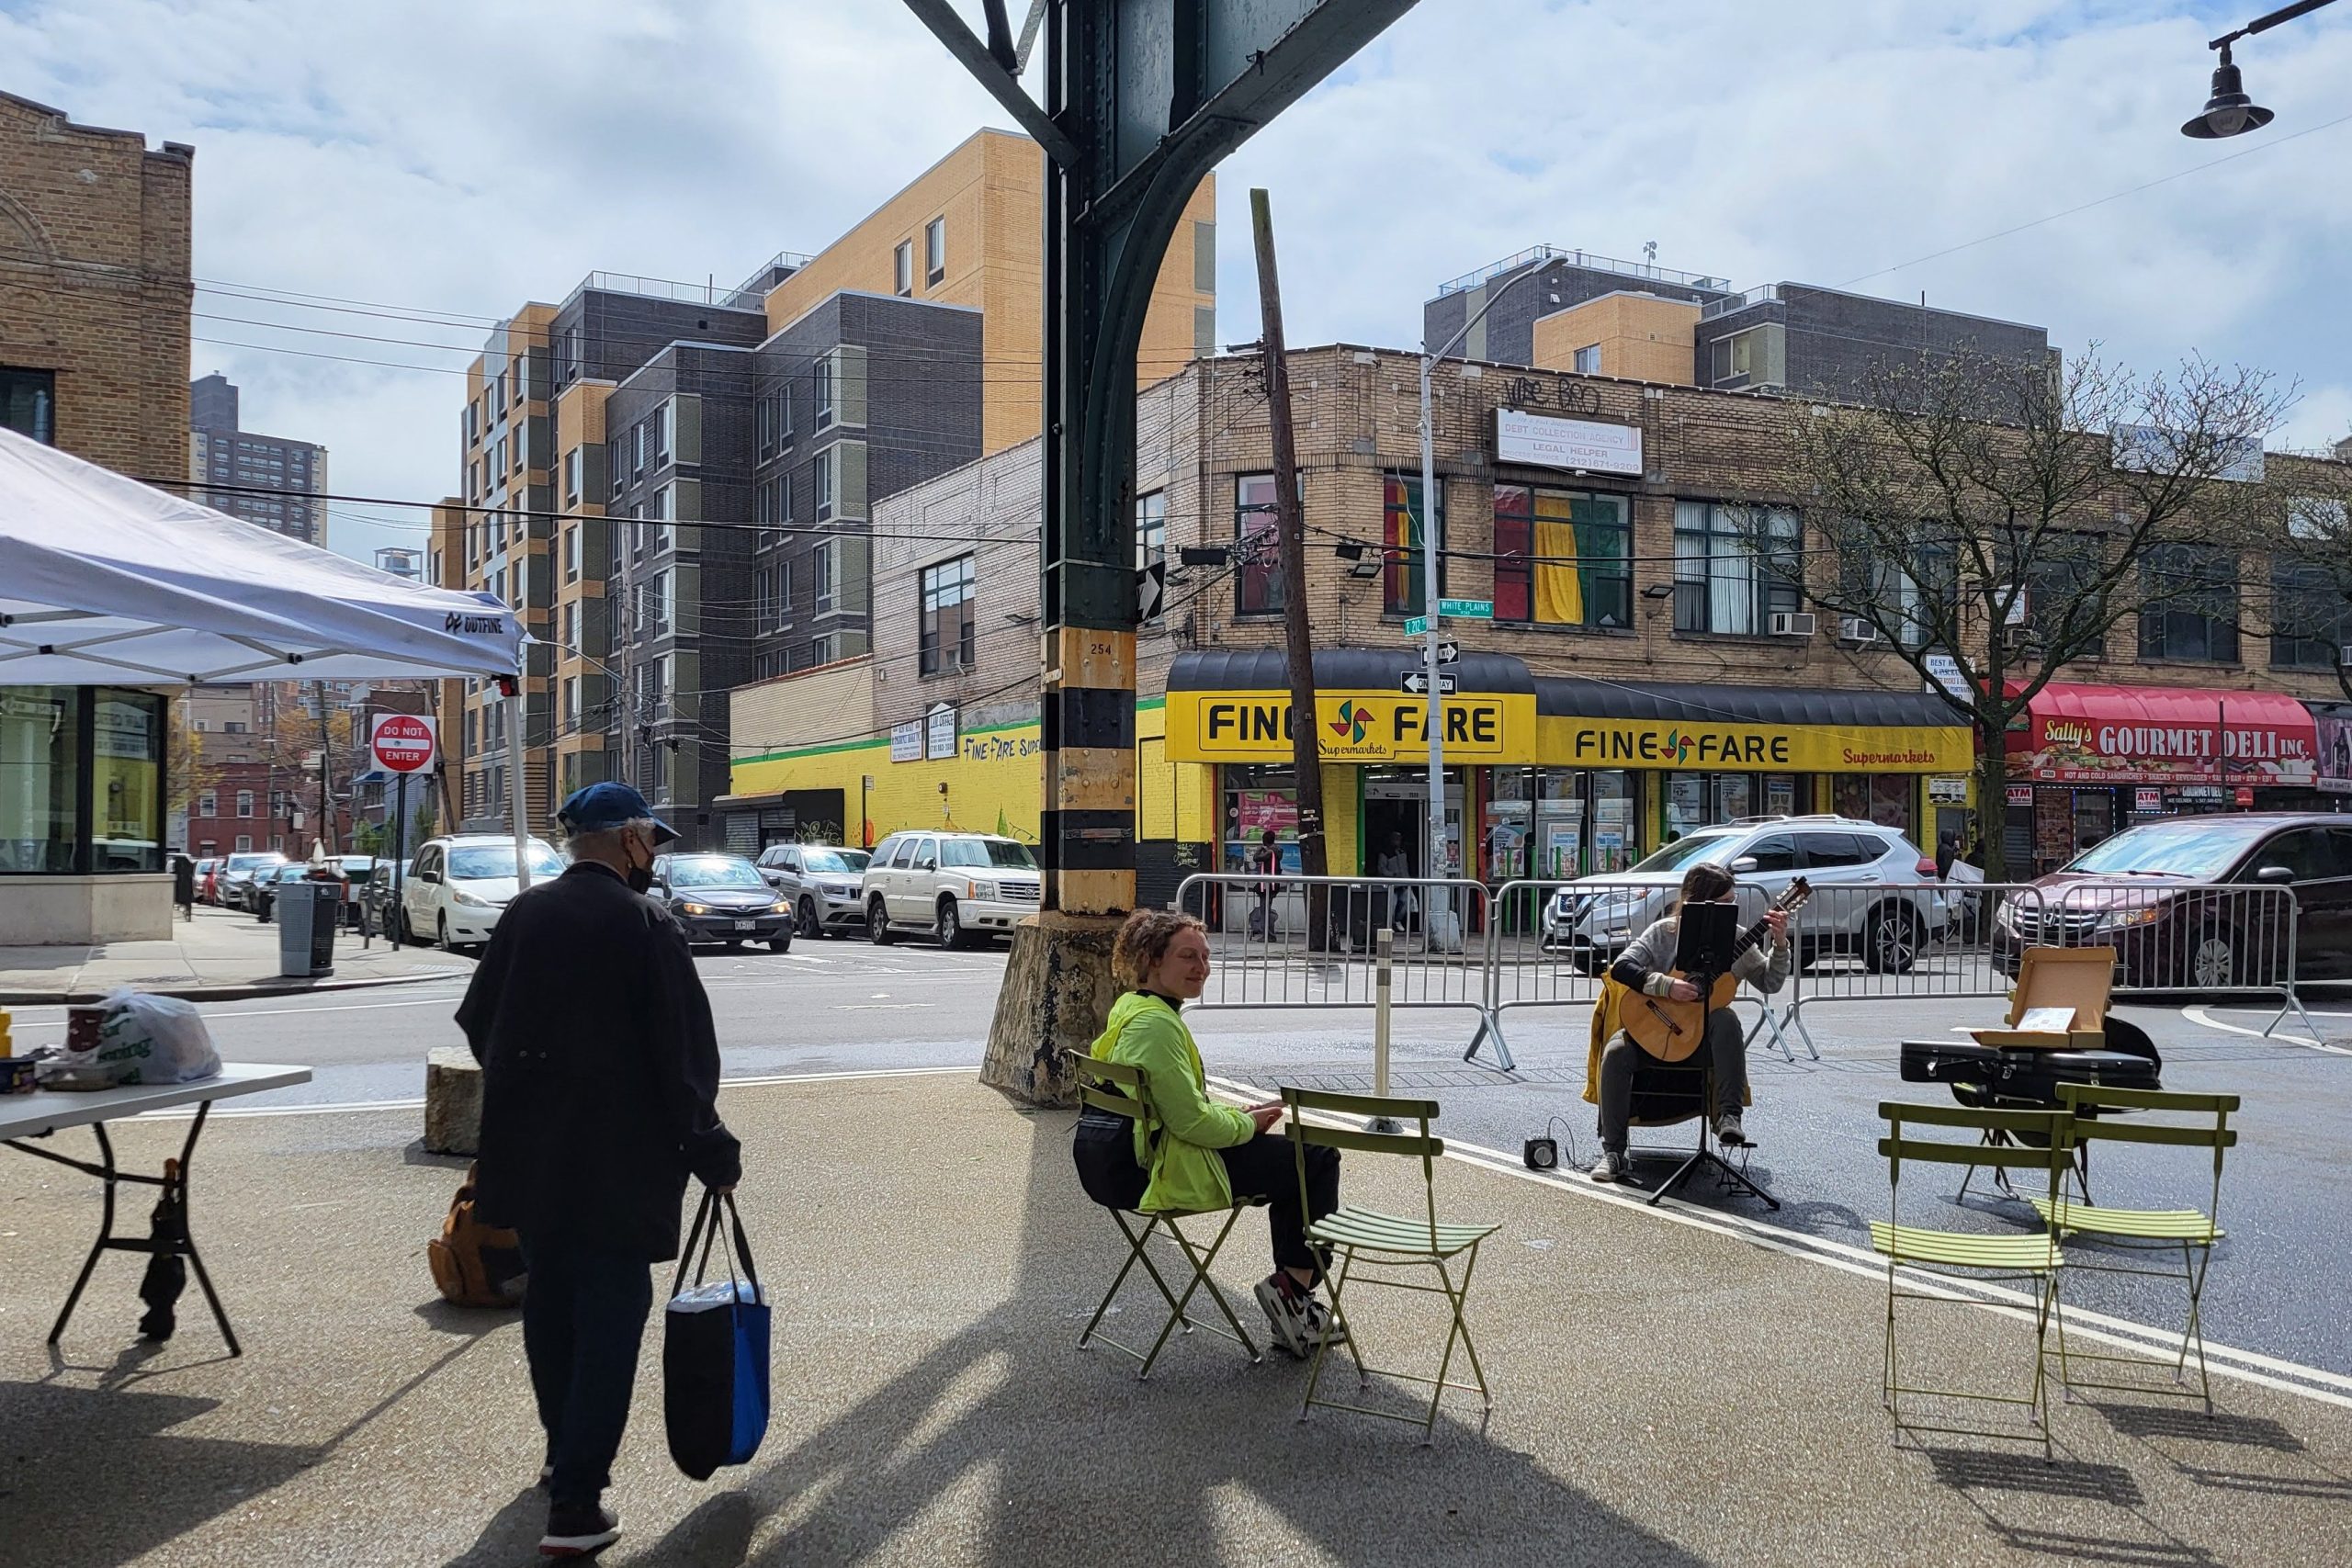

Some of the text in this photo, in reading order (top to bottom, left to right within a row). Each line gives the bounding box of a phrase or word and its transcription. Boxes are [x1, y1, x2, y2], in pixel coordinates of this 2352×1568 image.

[1505, 423, 1529, 434] DEBT
[1532, 426, 1587, 441] COLLECTION
[1589, 432, 1624, 446] AGENCY
[1532, 442, 1608, 458] LEGAL HELPER
[1442, 601, 1489, 612] WHITE PLAINS
[465, 616, 503, 634] OUTFINE
[1406, 622, 1409, 634] E
[1411, 619, 1420, 633] 212
[1091, 644, 1111, 655] 254
[1442, 649, 1453, 659] WAY
[1930, 659, 1945, 667] BEST
[384, 727, 424, 737] DO NOT
[2044, 719, 2310, 759] Sally's GOURMET DELI INC.
[964, 738, 989, 761] FINE
[990, 736, 1015, 762] FARE
[1317, 738, 1387, 757] Supermarkets
[1576, 730, 1789, 763] FINE FARE
[386, 750, 420, 761] ENTER
[1843, 748, 1935, 766] Supermarkets
[2077, 772, 2090, 780] AND
[2090, 772, 2105, 780] COLD
[2107, 773, 2143, 781] SANDWICHES
[2007, 788, 2030, 797] ATM
[2137, 793, 2159, 801] ATM
[2182, 785, 2210, 797] GOURMET
